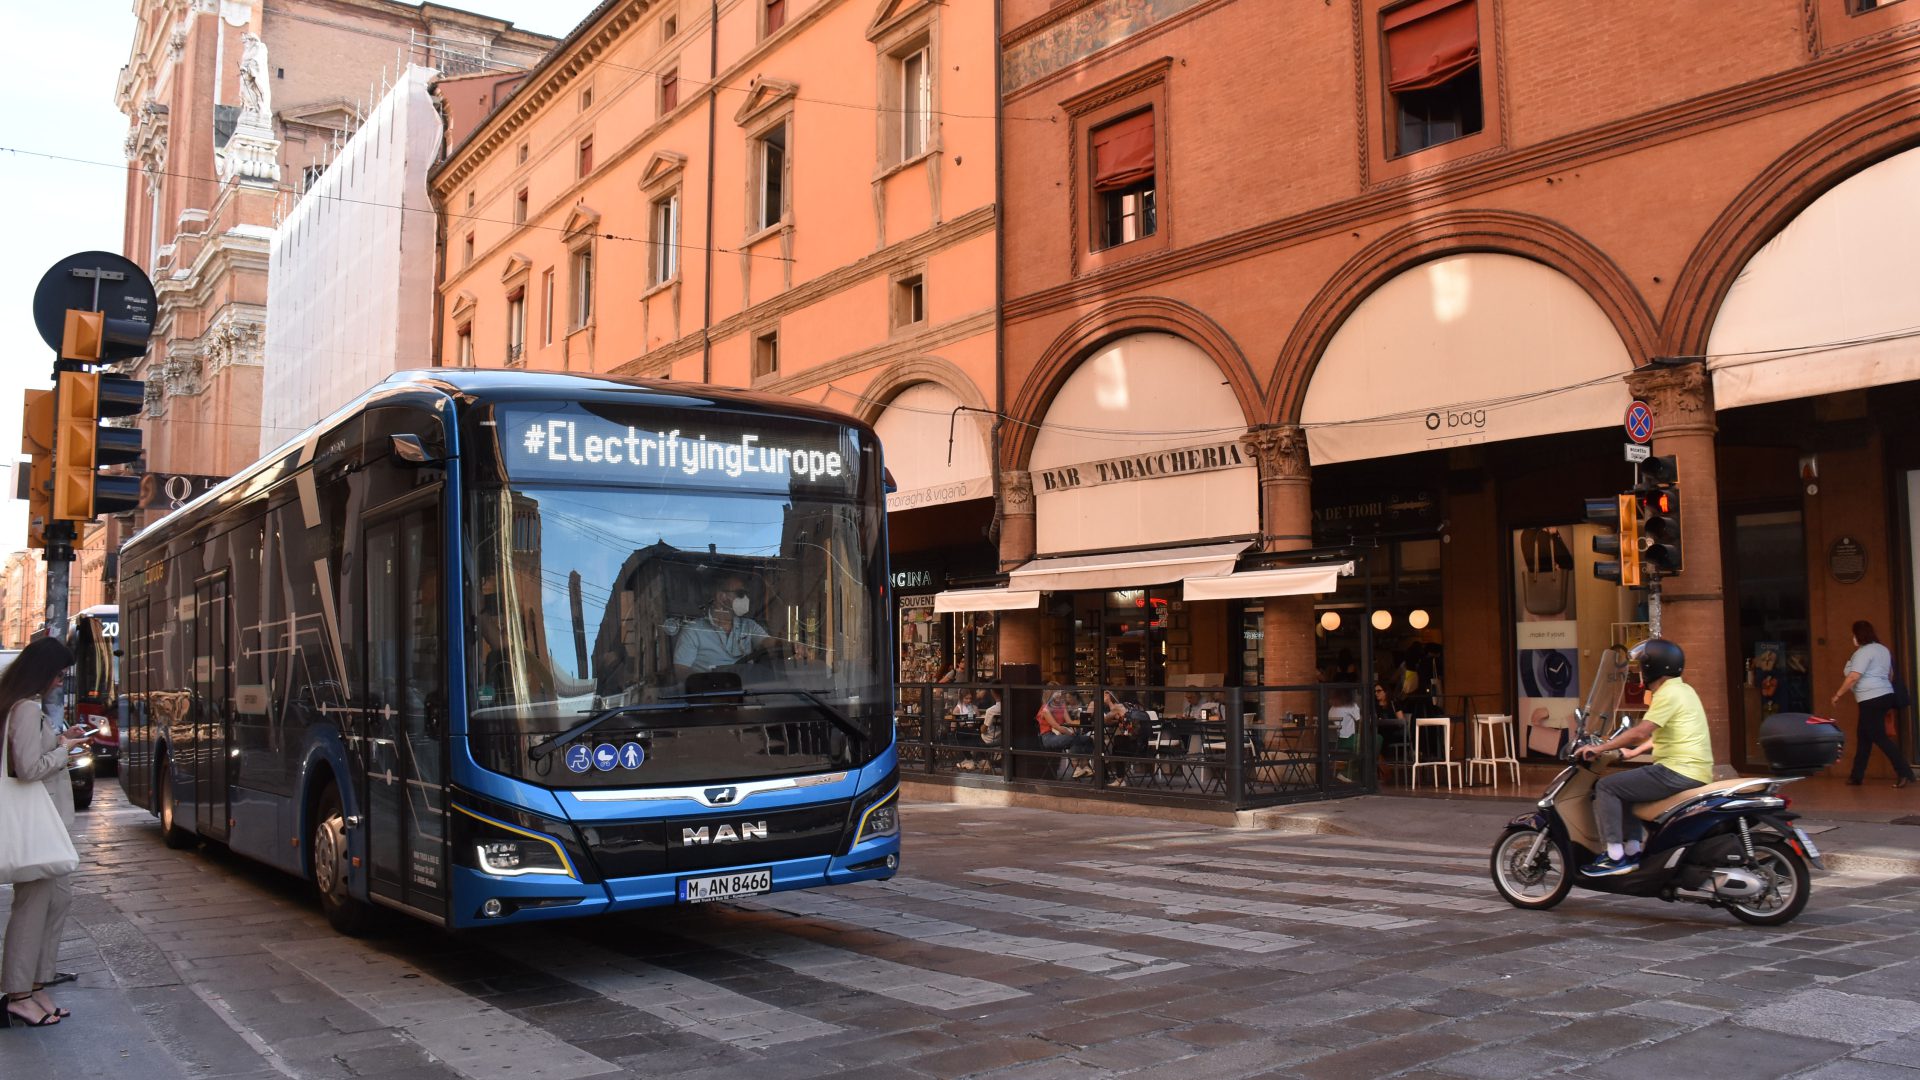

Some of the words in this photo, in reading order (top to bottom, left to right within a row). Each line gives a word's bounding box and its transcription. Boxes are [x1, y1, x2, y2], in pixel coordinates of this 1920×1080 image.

[1447, 409, 1486, 428] bag
[523, 420, 842, 482] #ElectrifyingEurope
[1042, 467, 1081, 490] BAR
[1095, 444, 1242, 482] TABACCHERIA
[925, 488, 932, 502] &
[102, 622, 119, 637] 20
[683, 821, 767, 846] MAN
[732, 873, 768, 892] 8466
